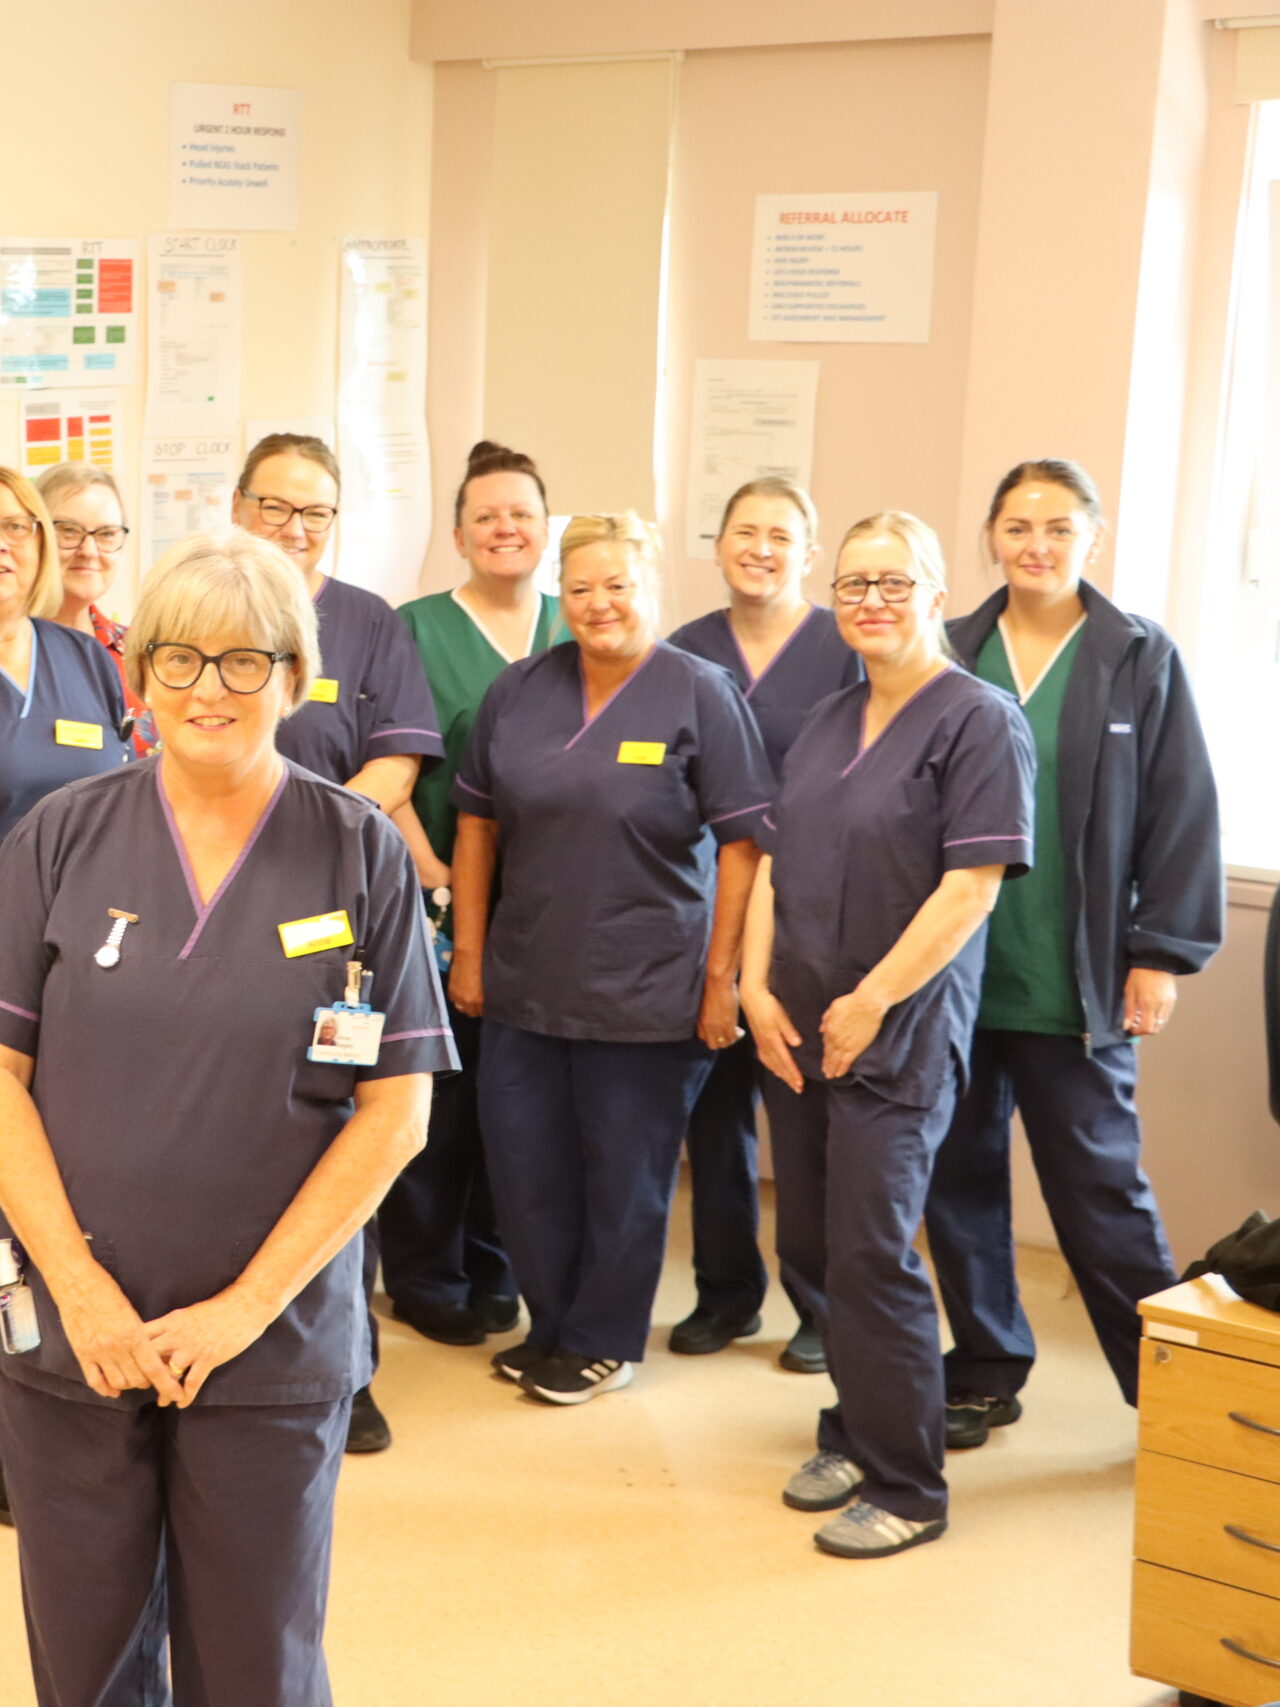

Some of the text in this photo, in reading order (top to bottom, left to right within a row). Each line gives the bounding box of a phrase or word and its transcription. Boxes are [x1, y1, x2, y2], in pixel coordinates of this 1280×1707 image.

[233, 103, 252, 115] RTT
[193, 124, 224, 134] URGENT
[231, 126, 252, 136] HOUR
[779, 210, 909, 224] REFERRAL ALLOCATE
[154, 442, 186, 456] STOP
